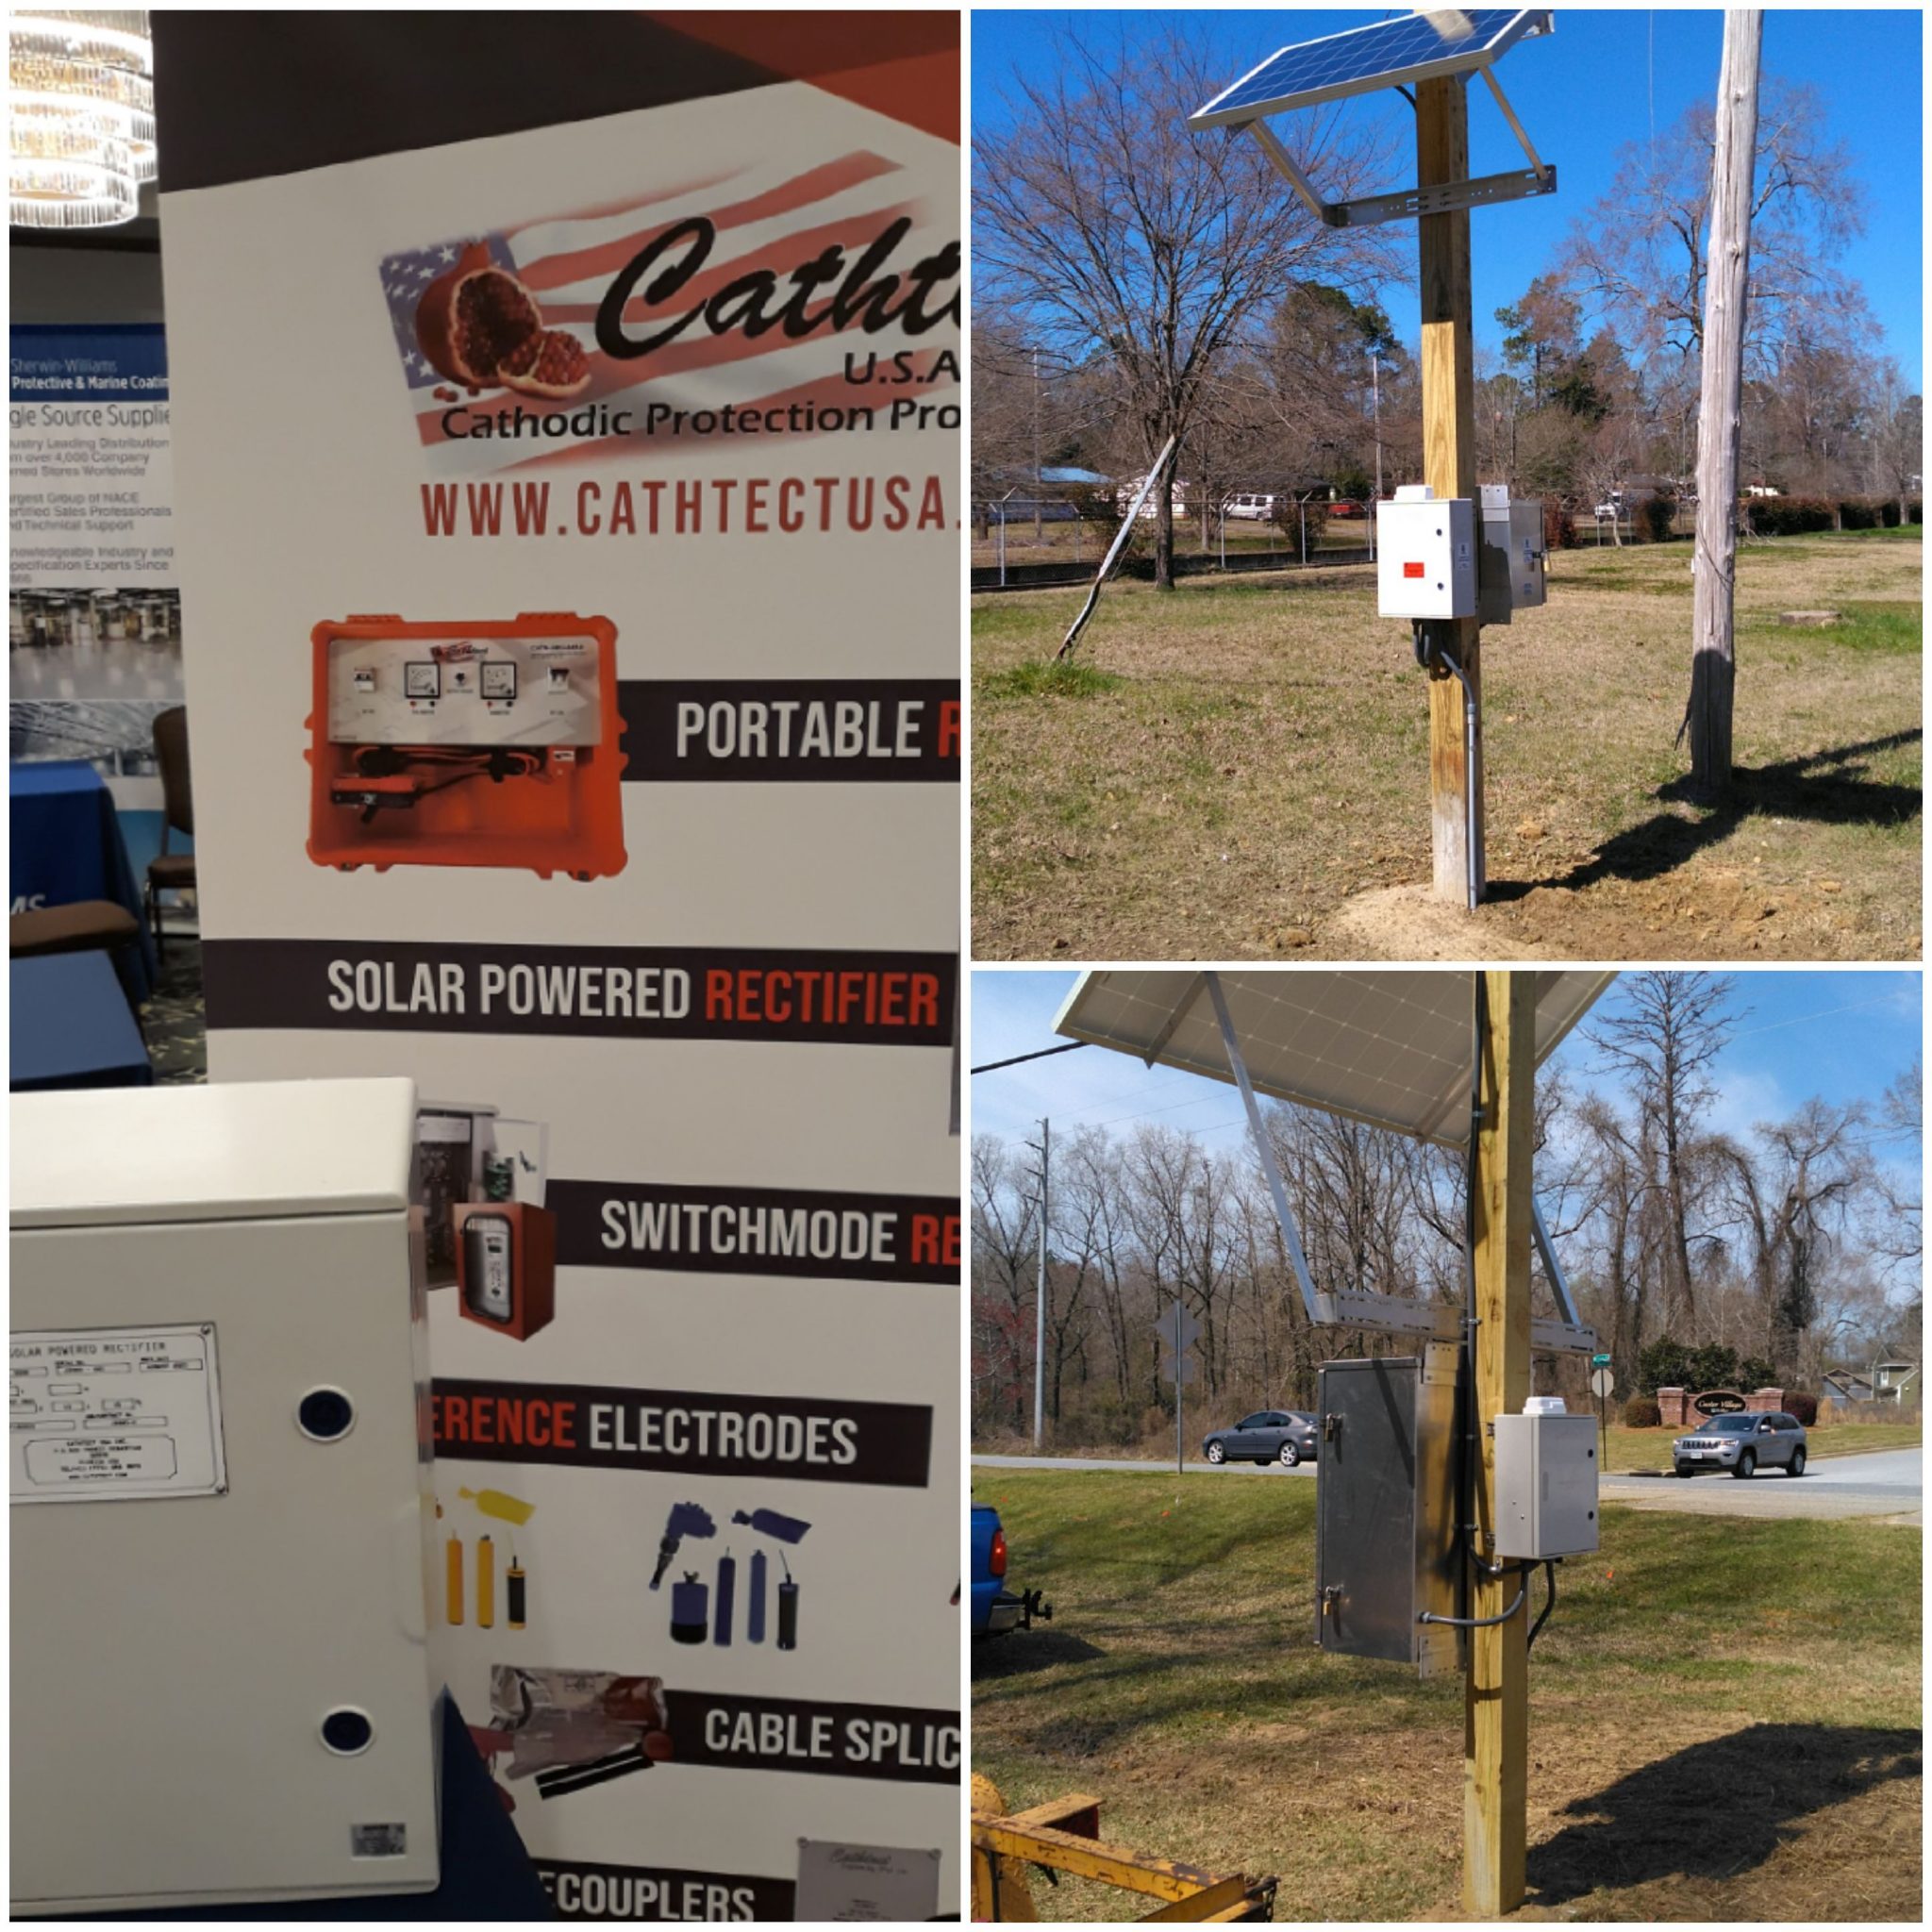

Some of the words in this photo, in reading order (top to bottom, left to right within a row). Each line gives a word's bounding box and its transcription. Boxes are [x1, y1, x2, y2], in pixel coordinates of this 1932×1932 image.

[10, 358, 118, 374] Sherwin-Williams
[844, 350, 960, 385] U.S.A
[11, 375, 74, 390] Protective
[75, 375, 86, 390] &
[88, 375, 128, 390] Marine
[9, 405, 37, 429] gle
[41, 404, 102, 426] Source
[441, 404, 633, 440] Cathodic
[646, 400, 874, 437] Protection
[891, 398, 960, 430] Pro
[46, 438, 95, 452] Leading
[99, 437, 170, 449] Distribution
[25, 453, 53, 463] over
[92, 452, 150, 465] Company
[41, 465, 80, 477] Stores
[82, 465, 146, 477] Worldwide
[46, 491, 86, 505] Group
[88, 492, 100, 503] of
[103, 491, 140, 503] NACE
[54, 505, 87, 517] Sales
[89, 505, 173, 517] Professionals
[24, 519, 82, 531] Technical
[85, 519, 134, 533] Support
[97, 546, 148, 561] Industry
[152, 546, 174, 558] and
[84, 558, 131, 573] Experts
[134, 558, 170, 571] Since
[676, 700, 924, 758] PORTABLE
[327, 958, 466, 1014] SOLAR
[480, 963, 691, 1019] POWERED
[706, 969, 940, 1026] RECTIFIER
[600, 1199, 898, 1262] SWITCHMODE
[910, 1212, 960, 1265] RE
[48, 1343, 97, 1357] POWERED
[103, 1341, 166, 1354] RECTIFIER
[589, 1403, 858, 1465] ELECTRODES
[705, 1707, 834, 1757] CABLE
[844, 1718, 960, 1770] SPLIC
